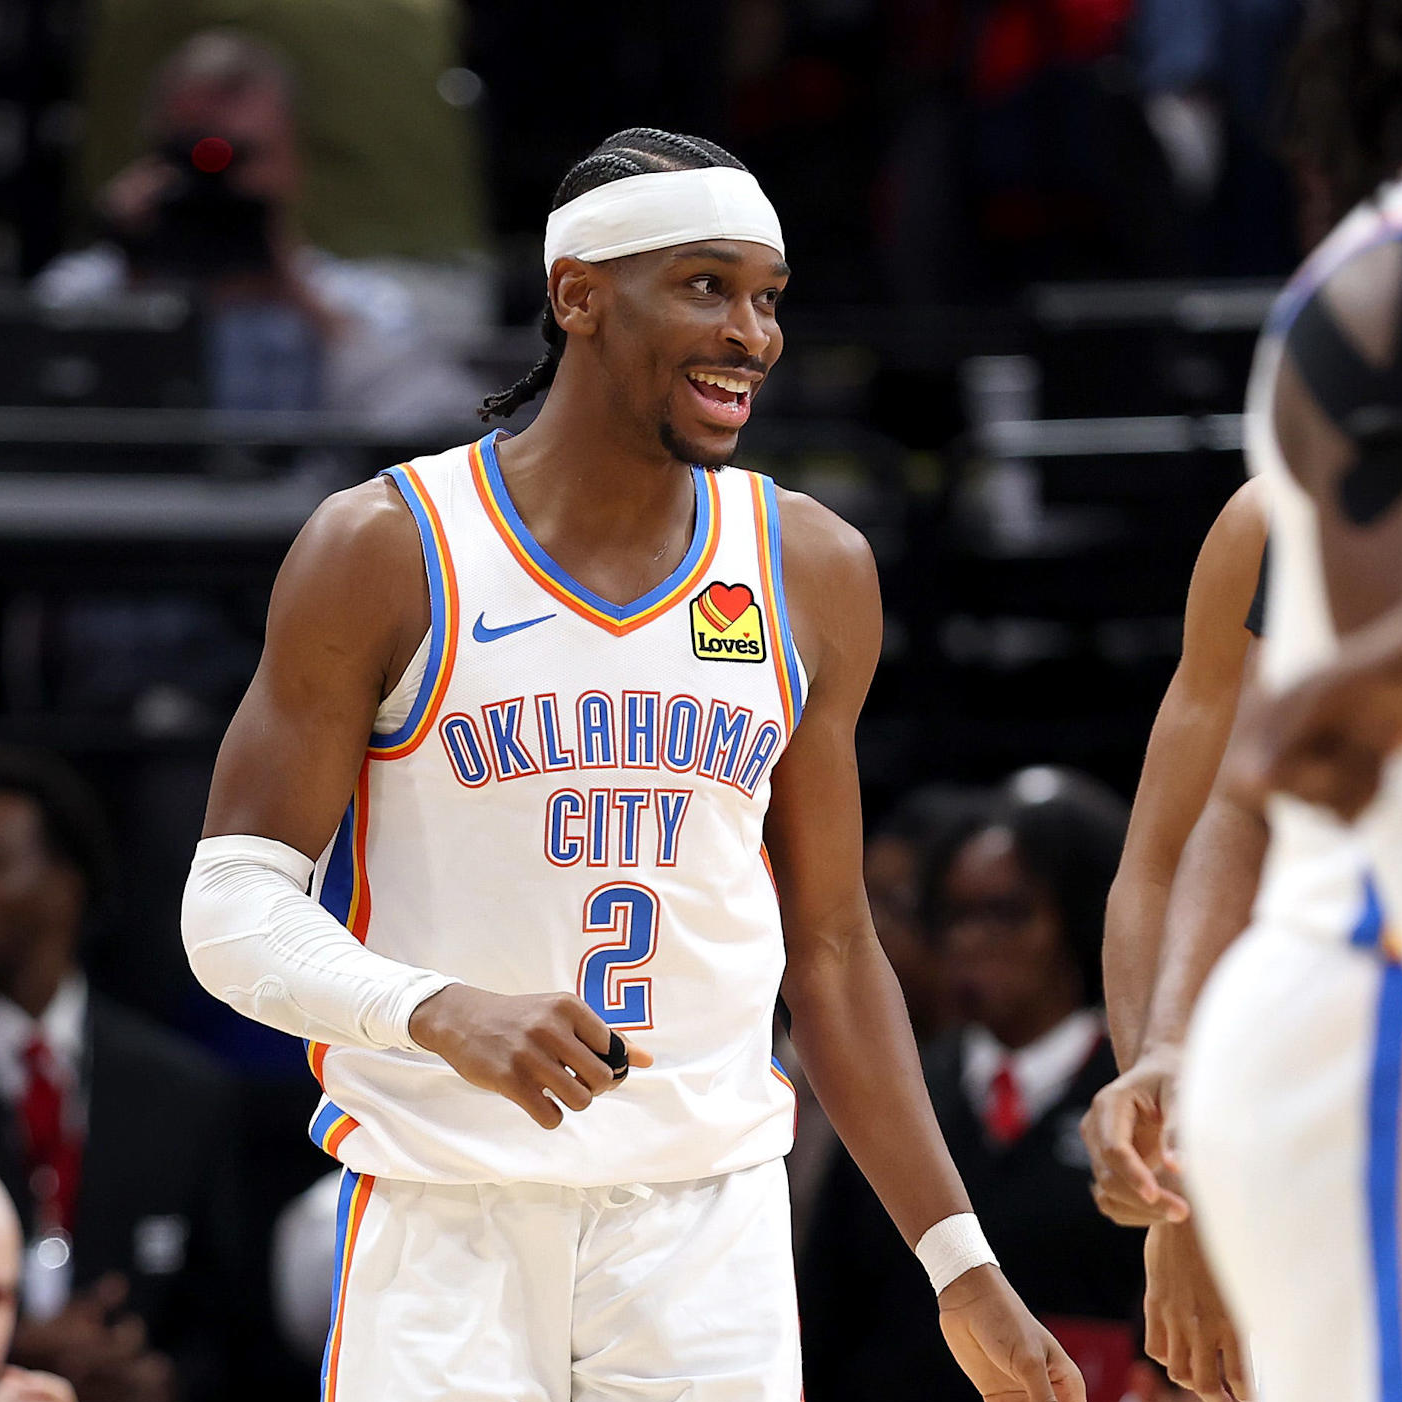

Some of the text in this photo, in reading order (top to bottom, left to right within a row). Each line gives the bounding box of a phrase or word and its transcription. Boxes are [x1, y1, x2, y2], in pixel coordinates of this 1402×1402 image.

[439, 690, 780, 798] OKLAHOMA
[544, 788, 693, 868] CITY
[577, 881, 661, 1031] 2
